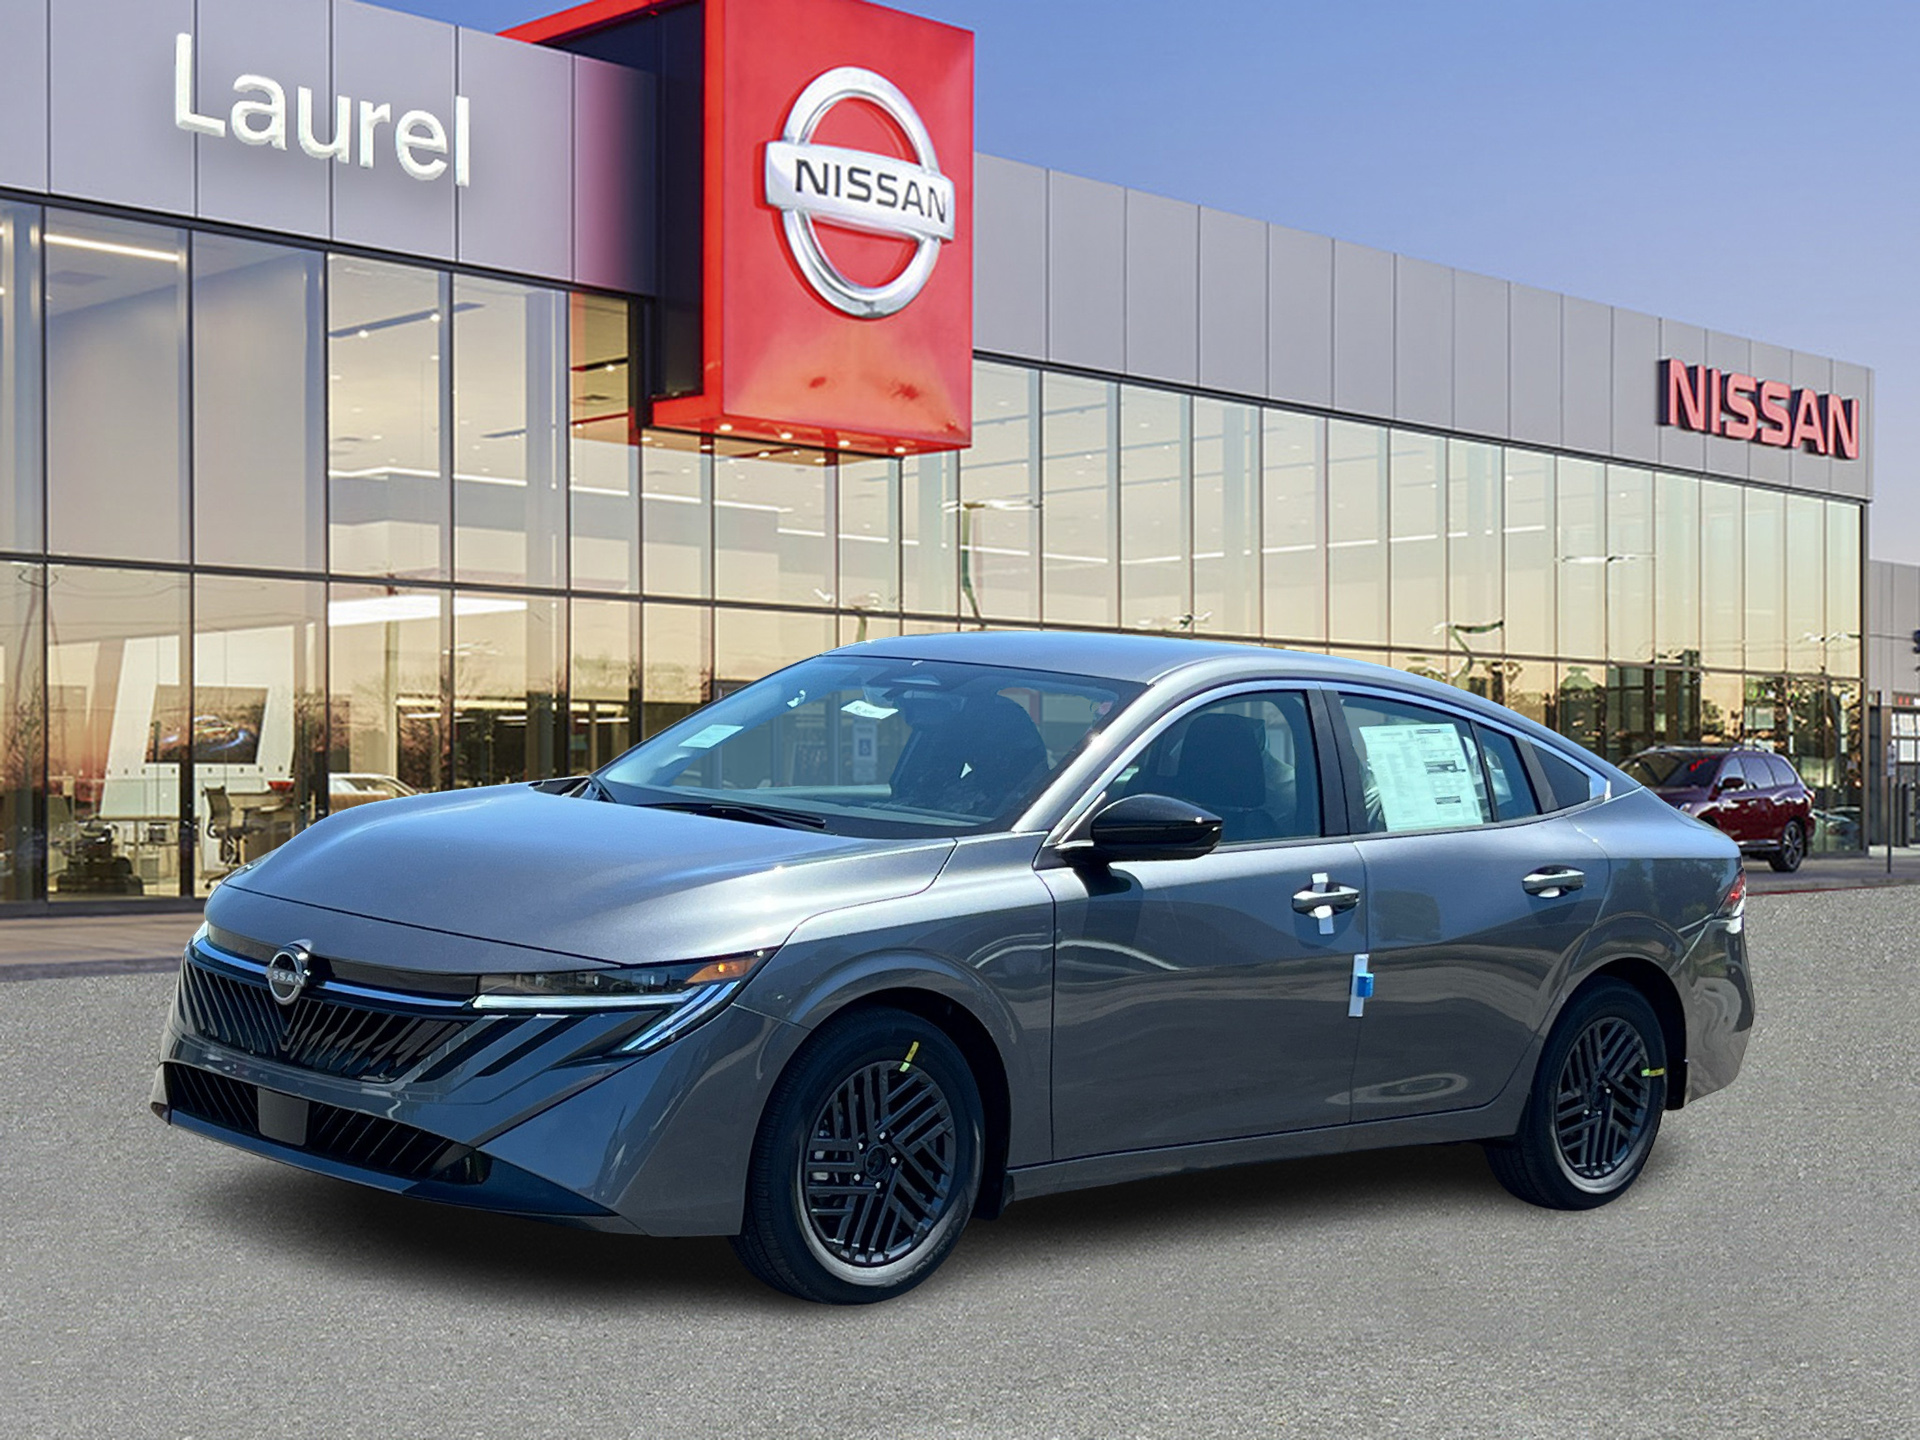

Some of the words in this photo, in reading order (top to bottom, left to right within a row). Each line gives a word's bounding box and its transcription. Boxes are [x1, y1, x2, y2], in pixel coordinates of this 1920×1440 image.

[175, 33, 469, 187] Laurel
[795, 158, 946, 223] NISSAN
[1658, 358, 1859, 460] NISSAN
[268, 970, 305, 986] SSAN
